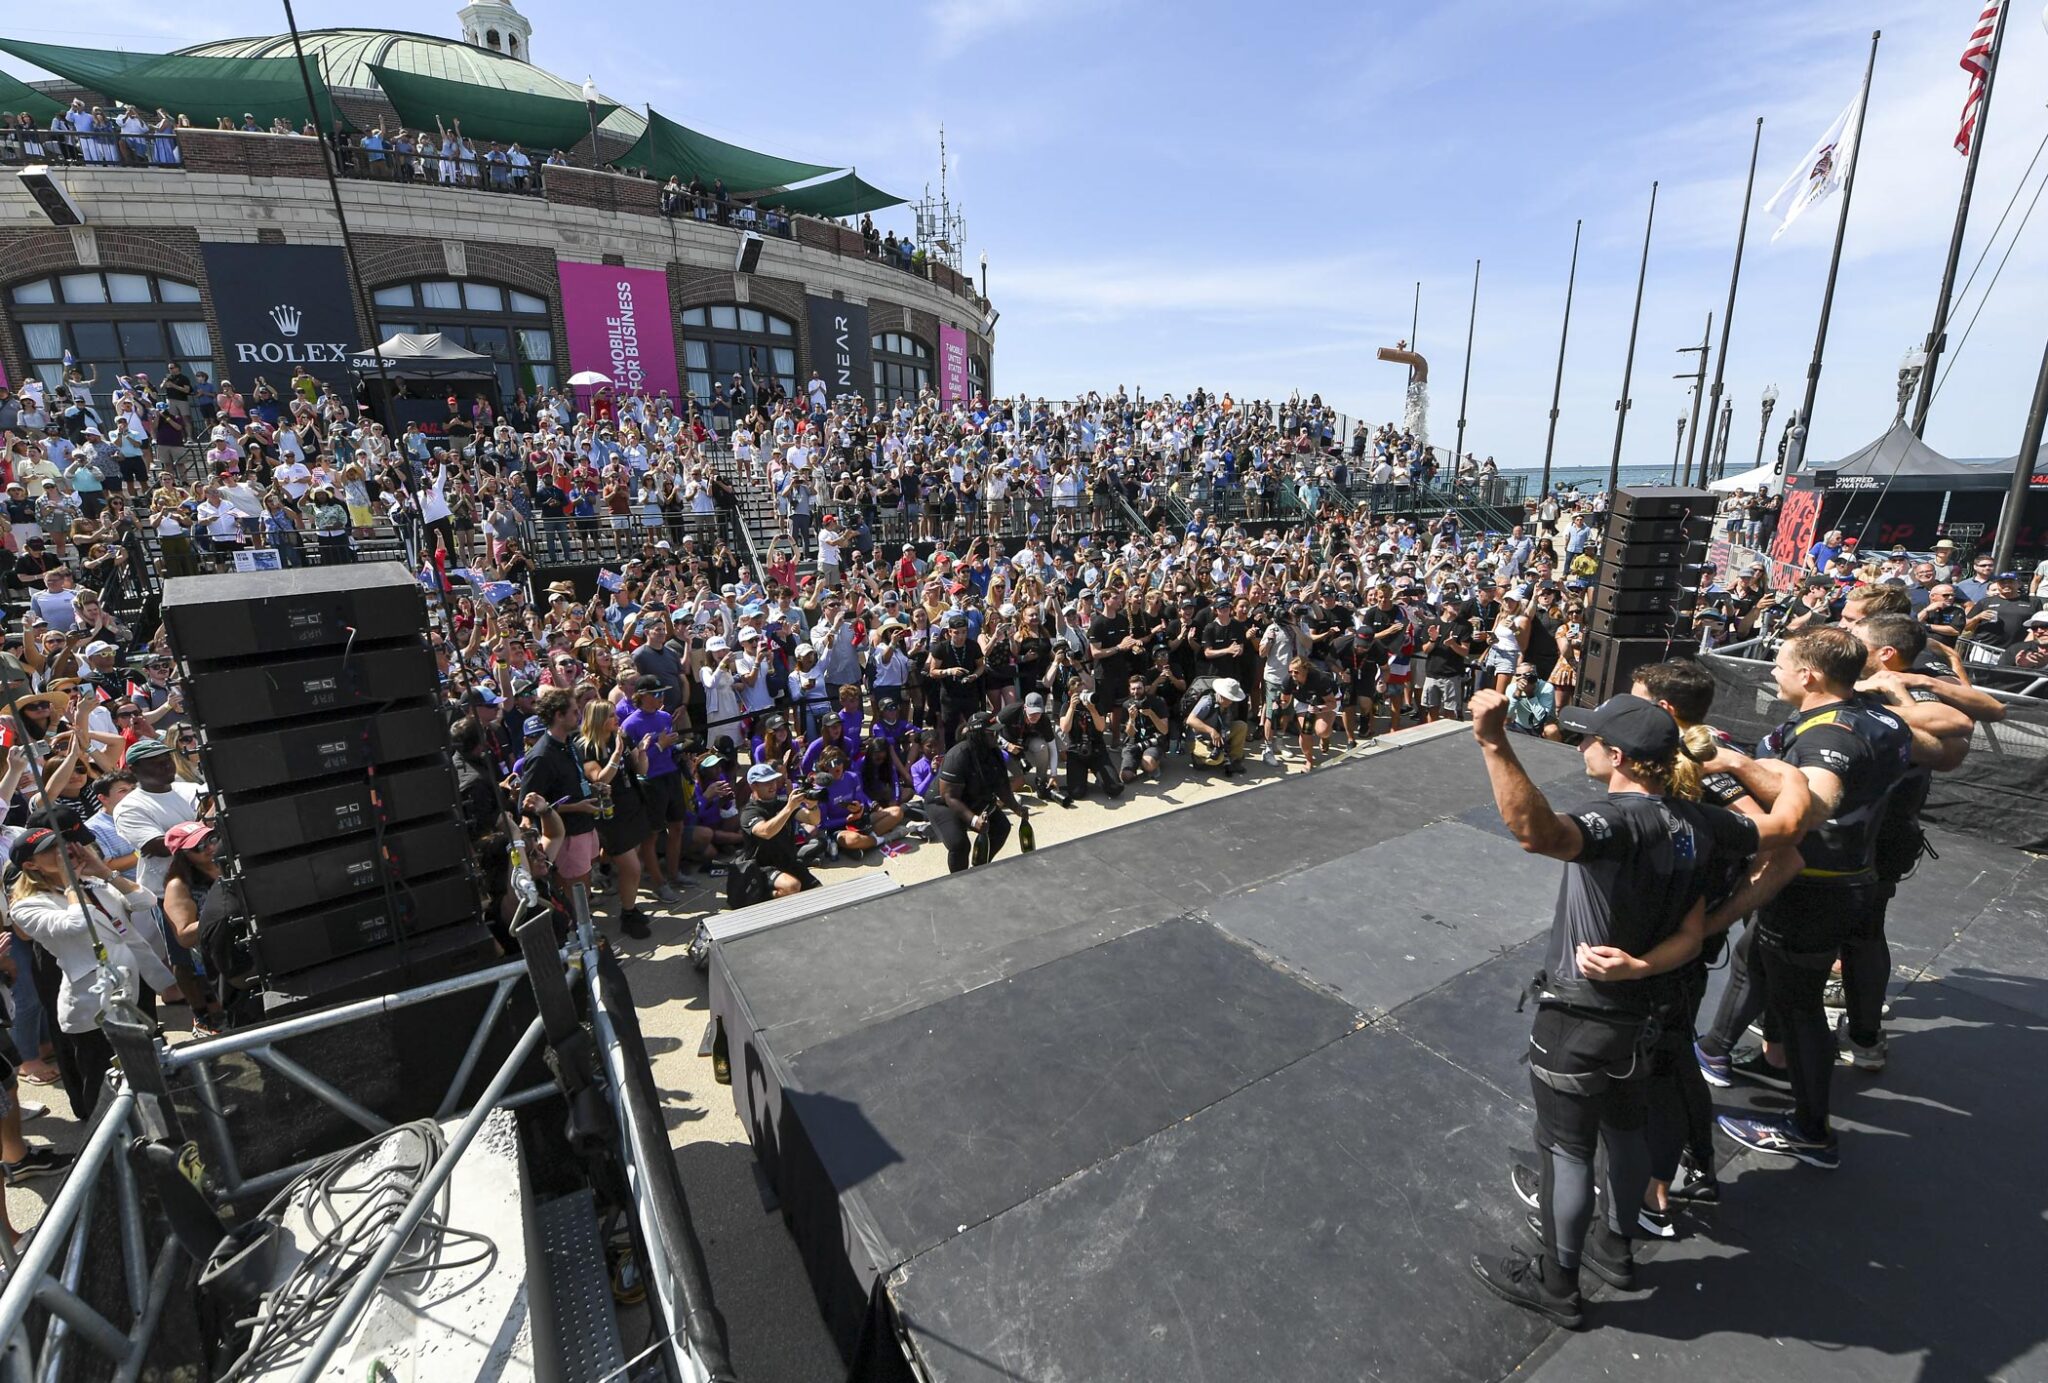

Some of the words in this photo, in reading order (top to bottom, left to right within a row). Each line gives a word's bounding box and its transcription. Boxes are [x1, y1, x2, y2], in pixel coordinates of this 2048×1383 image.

[616, 281, 639, 357] BUSINESS
[234, 342, 348, 363] ROLEX
[606, 316, 628, 389] T-MOBILE
[626, 360, 643, 390] FOR
[1834, 476, 1875, 484] OWERED
